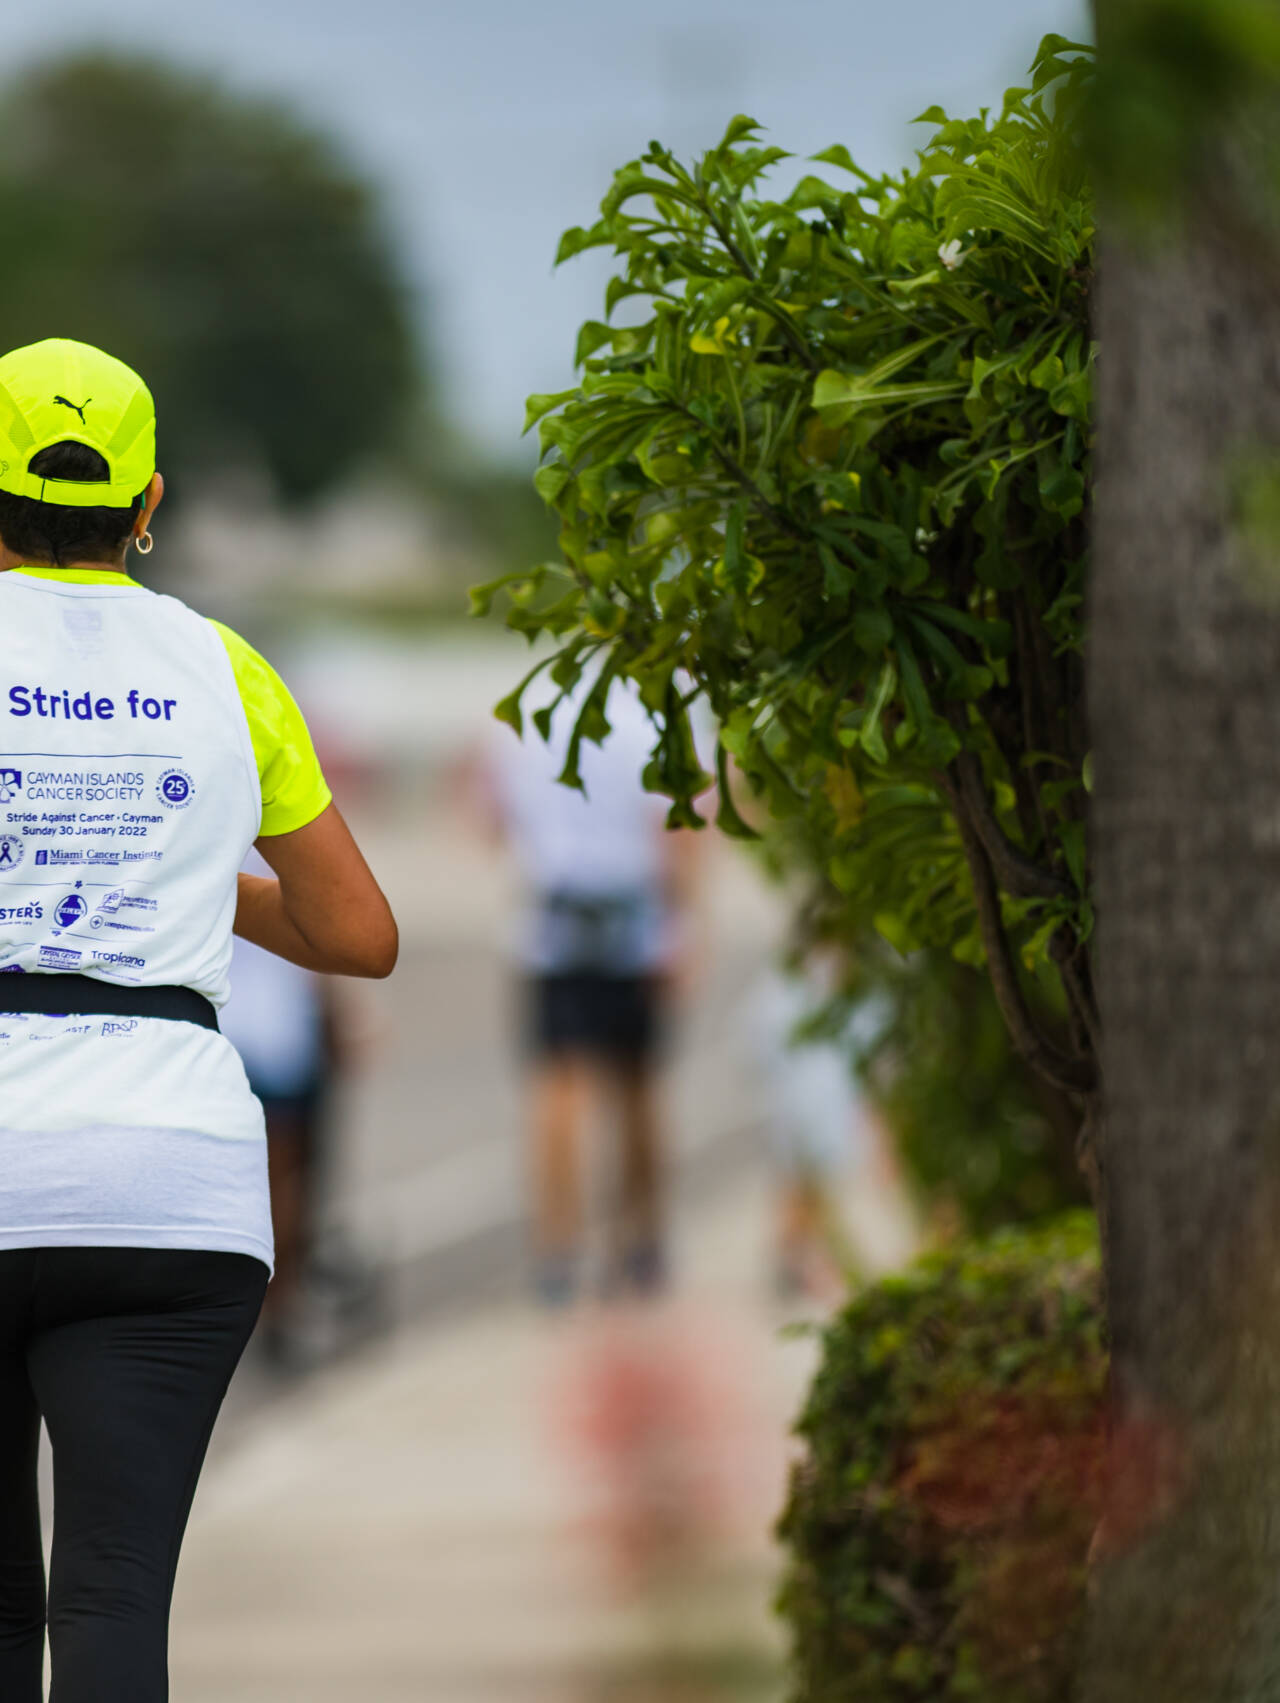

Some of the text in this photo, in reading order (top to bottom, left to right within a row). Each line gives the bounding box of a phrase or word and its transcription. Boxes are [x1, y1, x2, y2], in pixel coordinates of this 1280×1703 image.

[8, 685, 115, 720] Stride
[127, 689, 177, 721] for
[26, 771, 144, 786] CAYMAN ISLANDS
[26, 787, 144, 801] CANCER SOCIETY
[166, 780, 186, 795] 25
[6, 812, 164, 825] Stride Against Cancer Cayman
[22, 825, 147, 837] Sunday 30 January 2022
[50, 849, 163, 861] Miami Cancer Institute
[91, 950, 146, 967] Tropicana
